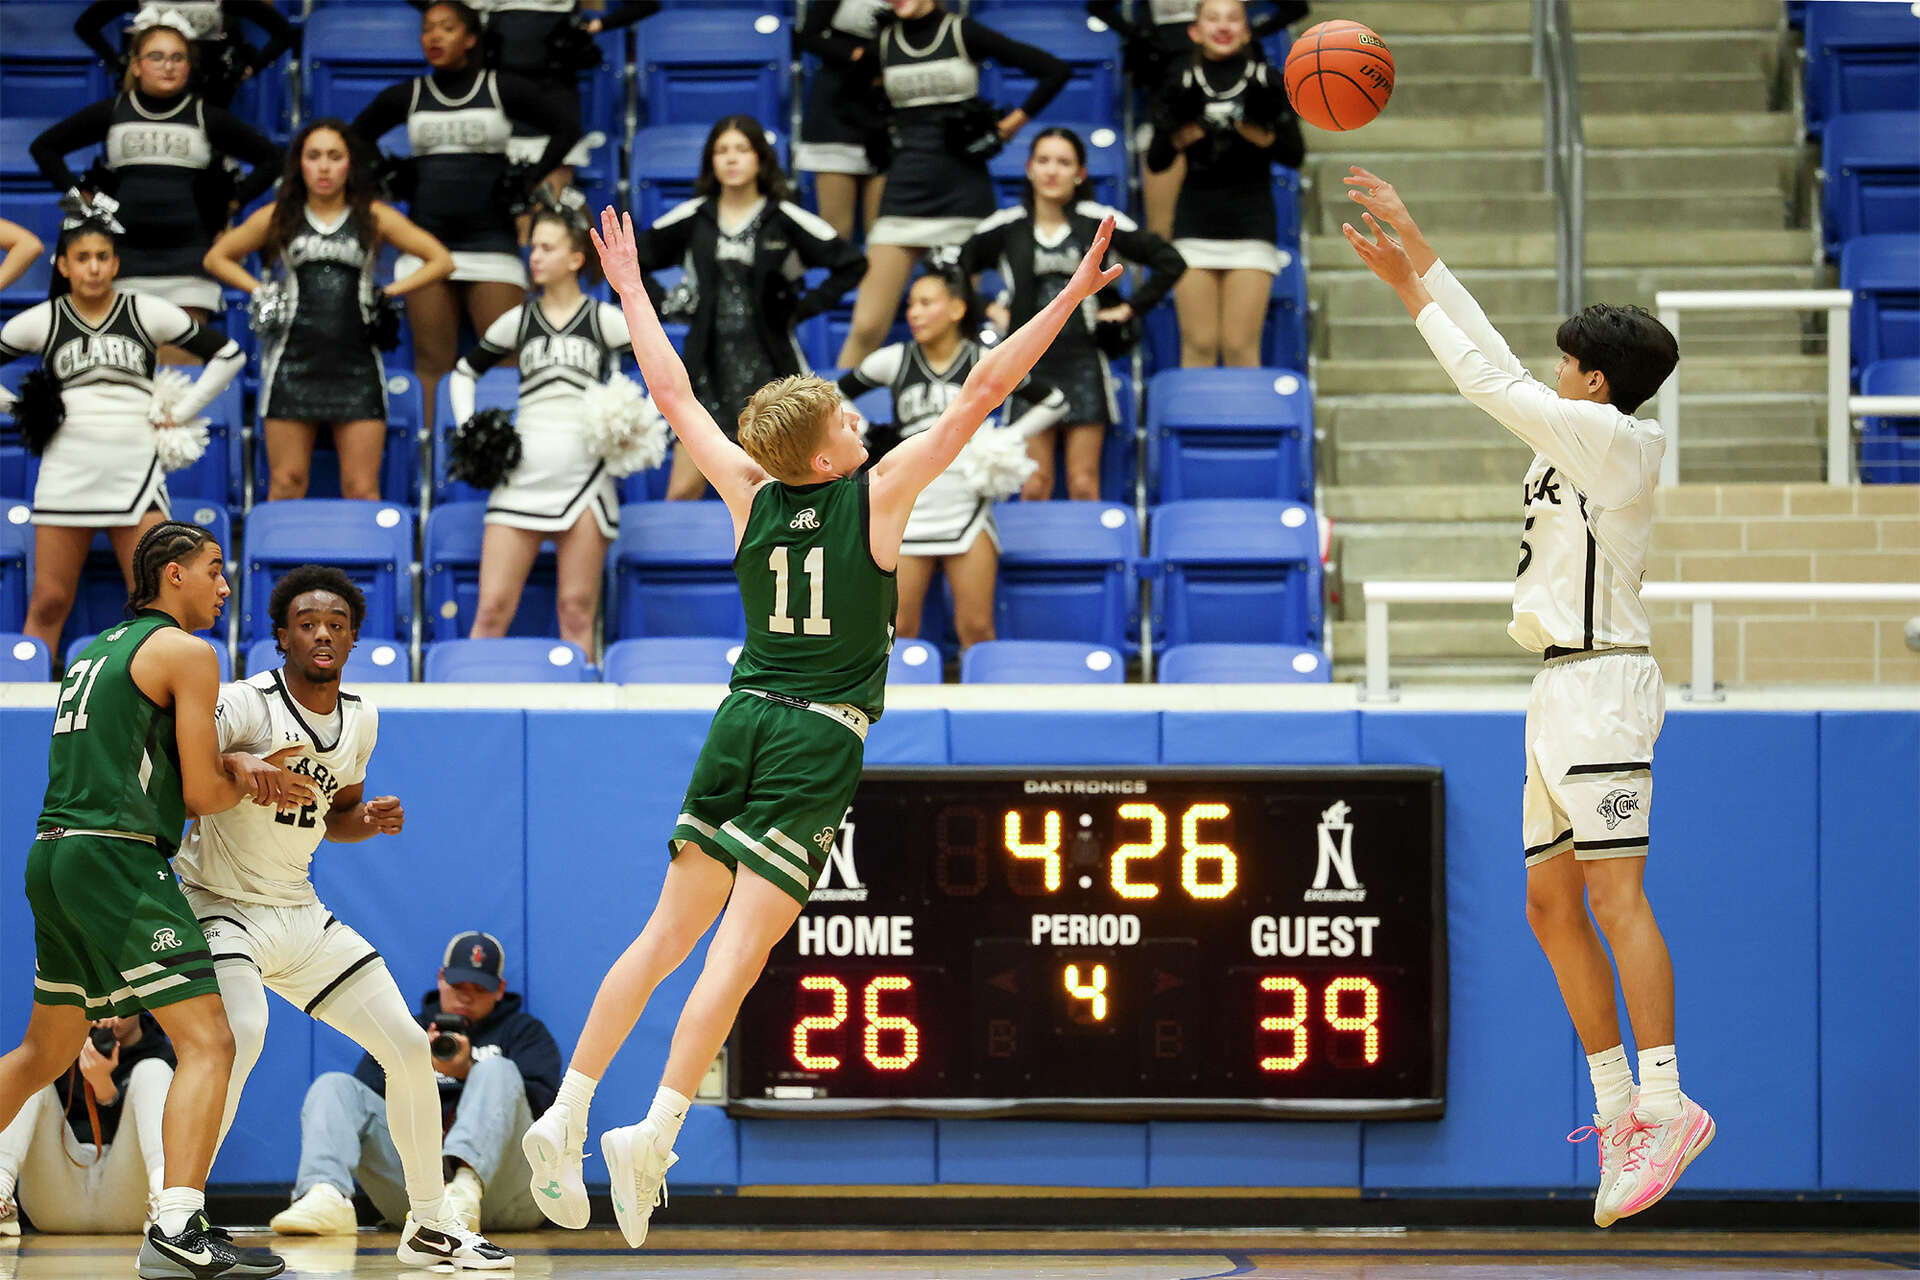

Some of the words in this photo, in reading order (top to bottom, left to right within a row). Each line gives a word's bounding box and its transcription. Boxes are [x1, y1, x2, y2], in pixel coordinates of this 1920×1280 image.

[53, 334, 147, 380] CLARK
[519, 334, 602, 377] CLARK
[768, 546, 831, 636] 11
[52, 655, 109, 737] 21
[1024, 780, 1148, 794] DAKTRONICS
[798, 915, 914, 956] HOME
[1031, 913, 1141, 946] PERIOD
[1251, 915, 1381, 957] GUEST
[1064, 964, 1107, 1020] 4
[794, 976, 919, 1070] 26
[1260, 977, 1379, 1071] 39
